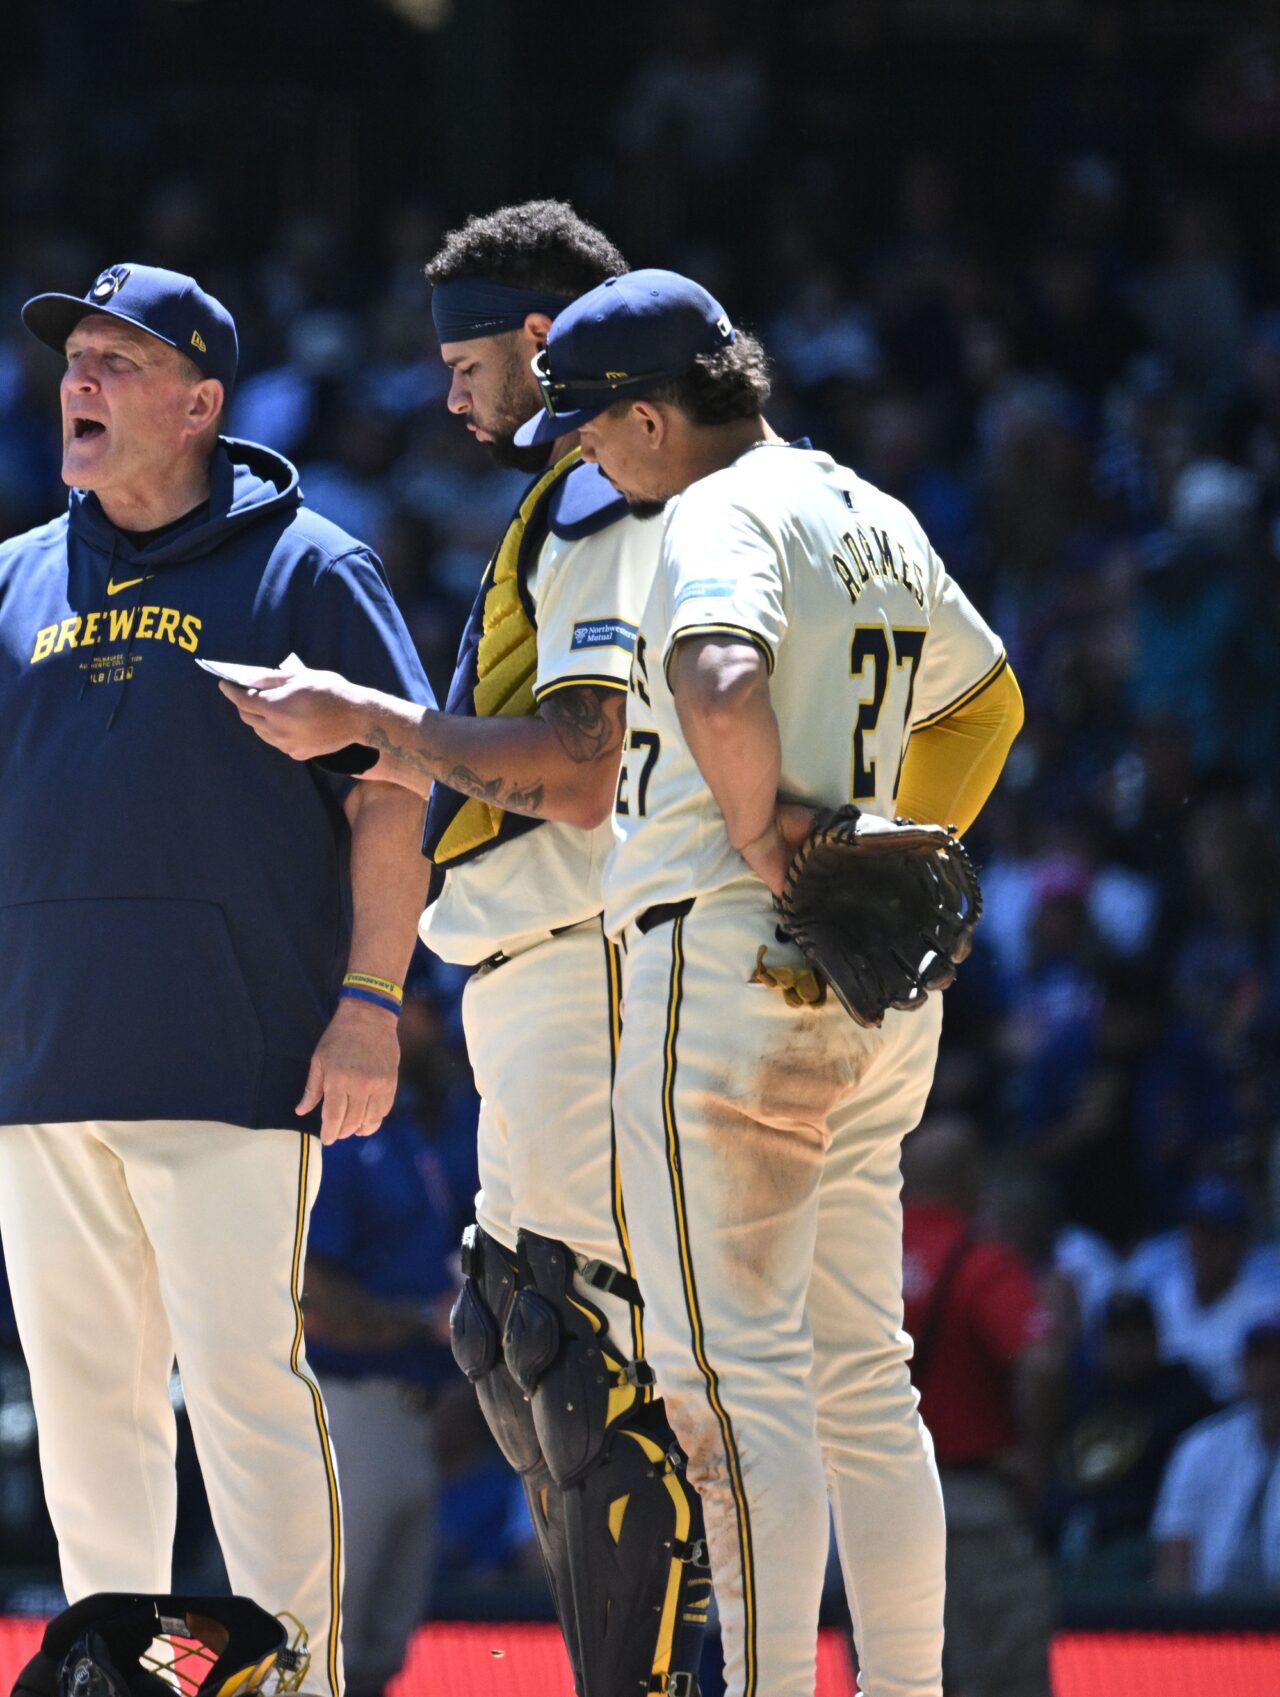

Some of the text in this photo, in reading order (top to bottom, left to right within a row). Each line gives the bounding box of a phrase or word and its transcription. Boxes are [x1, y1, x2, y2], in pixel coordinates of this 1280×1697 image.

[30, 606, 202, 664] BREWERS
[587, 632, 613, 642] Mutual
[588, 625, 637, 640] Northwestern
[850, 623, 929, 803] 27
